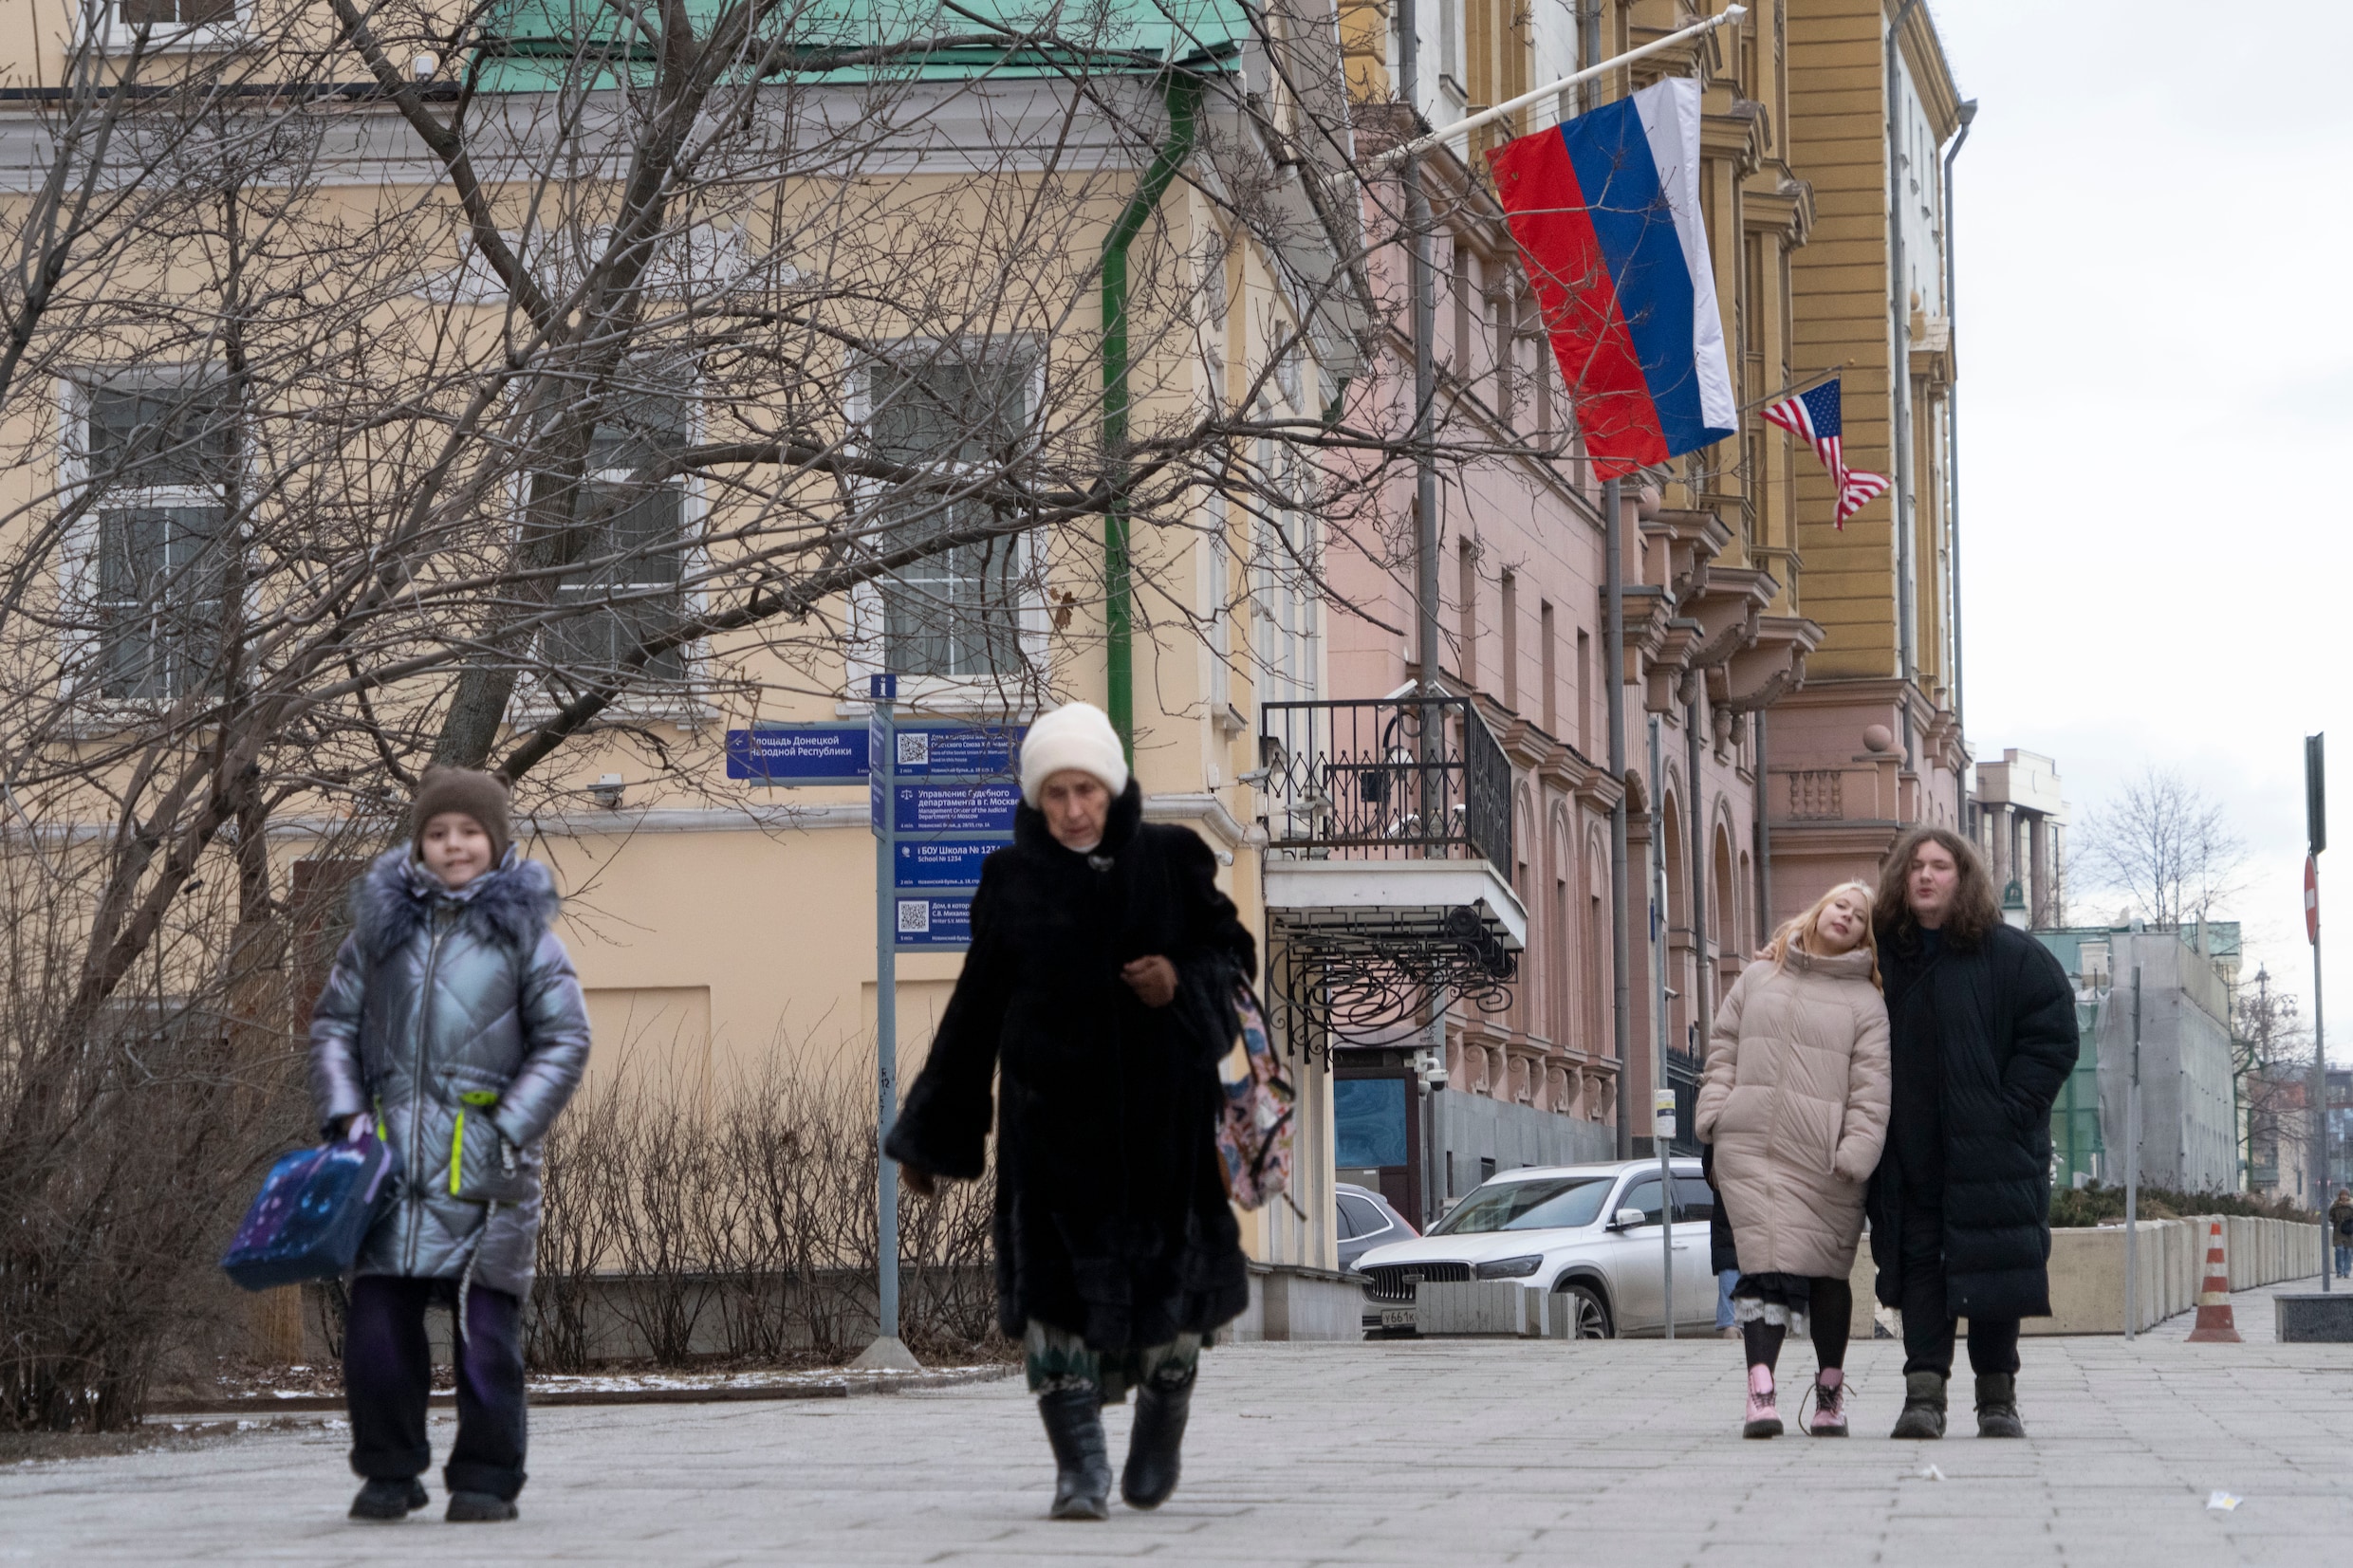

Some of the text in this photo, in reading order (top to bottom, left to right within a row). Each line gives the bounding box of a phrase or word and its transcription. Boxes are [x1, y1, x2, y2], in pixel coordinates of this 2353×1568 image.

[751, 735, 840, 747] лощадь Донецкой
[798, 747, 852, 758] Республики
[918, 789, 966, 799] Управление
[917, 799, 975, 807] департамента
[939, 846, 968, 855] Школа
[969, 846, 979, 855] №
[932, 902, 947, 911] Дом,
